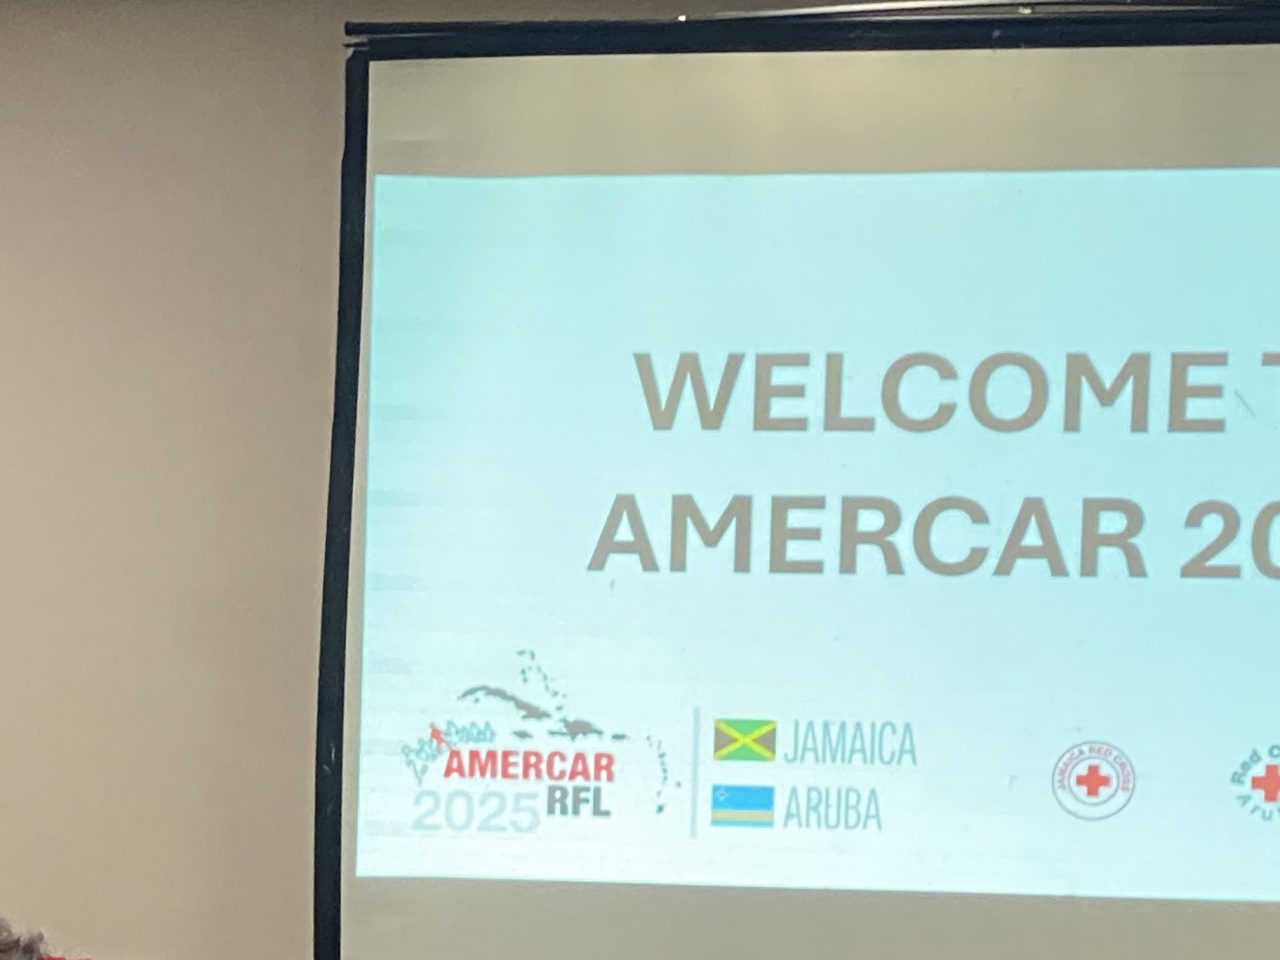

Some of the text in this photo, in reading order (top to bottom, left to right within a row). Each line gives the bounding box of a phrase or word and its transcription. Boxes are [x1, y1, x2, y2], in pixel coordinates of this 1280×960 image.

[633, 351, 1229, 433] WELCOME
[587, 494, 1148, 579] AMERCAR
[443, 749, 615, 782] AMERCAR
[783, 719, 917, 766] JAMAICA
[411, 785, 611, 834] 2025 RFL
[783, 786, 882, 831] ARUBA
[1236, 794, 1280, 821] Aru
